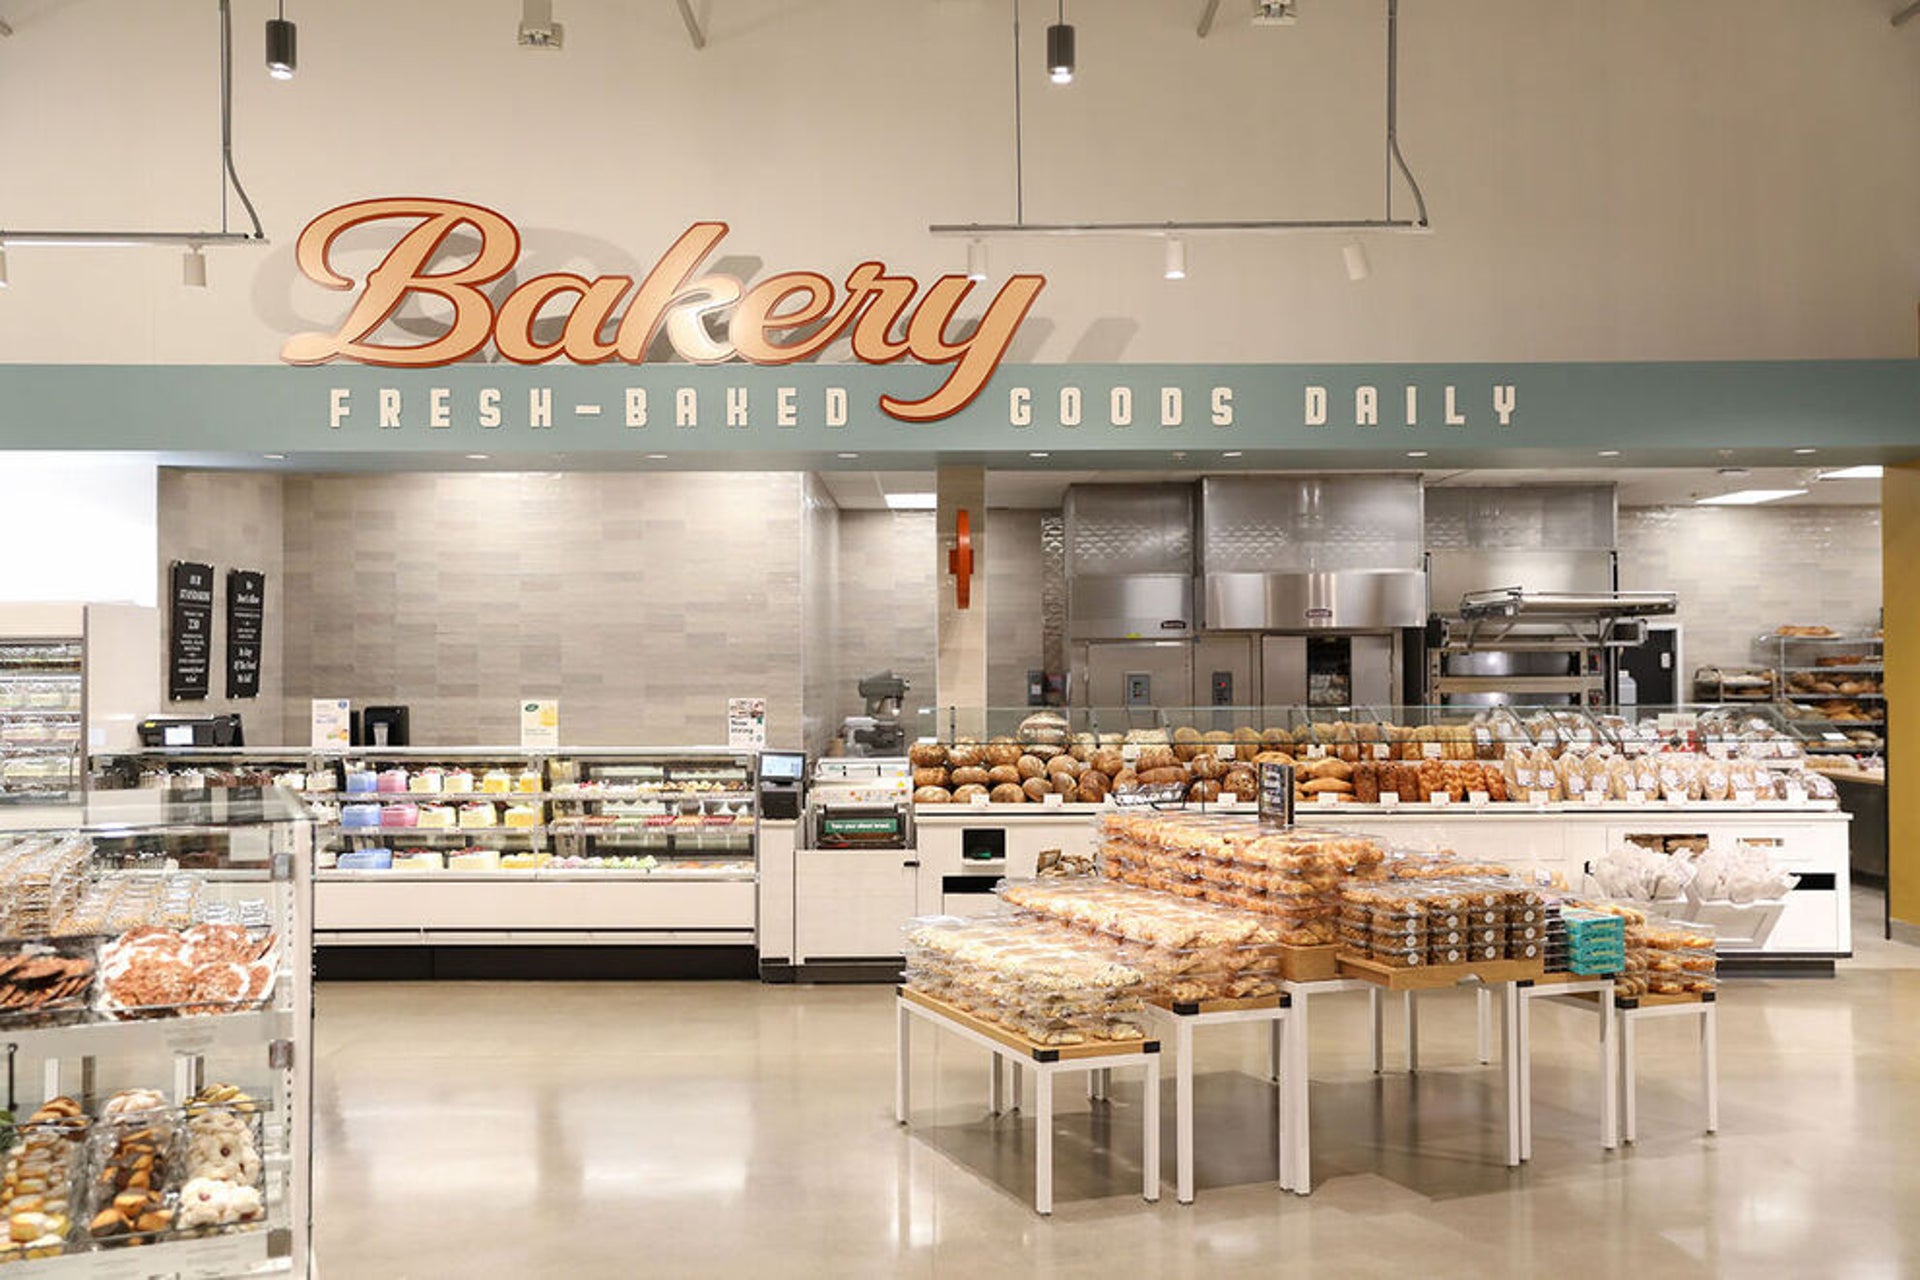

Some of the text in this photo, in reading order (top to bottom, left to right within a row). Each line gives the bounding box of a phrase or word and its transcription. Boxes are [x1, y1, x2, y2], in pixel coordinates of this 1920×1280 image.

[279, 197, 1047, 422] Bakery
[329, 385, 1516, 428] FRESH-BAKED GOODS DAILY
